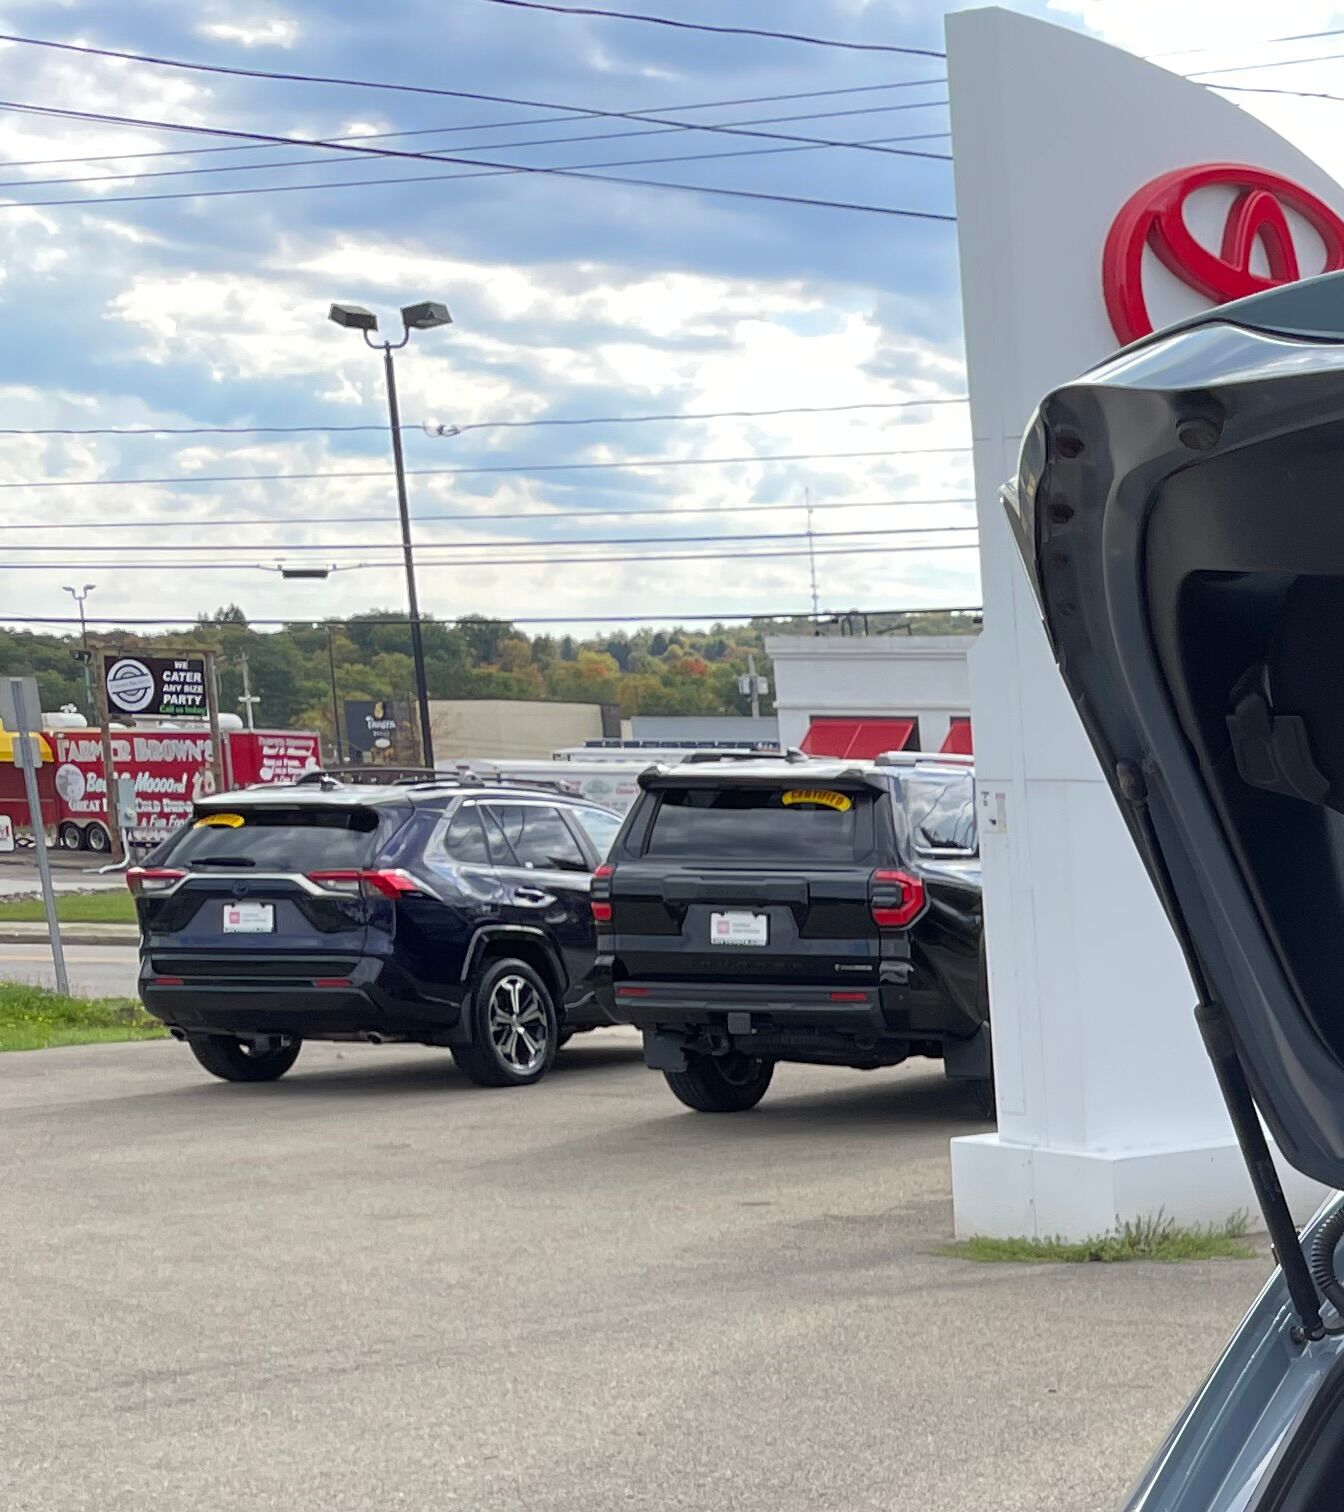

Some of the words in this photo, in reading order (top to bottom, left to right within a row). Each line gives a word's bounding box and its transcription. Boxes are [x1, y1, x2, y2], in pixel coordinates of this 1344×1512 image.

[174, 660, 189, 670] WE
[162, 670, 202, 683] CATER
[162, 683, 182, 693] ANY
[183, 684, 204, 694] SIZE
[163, 694, 202, 706] PARTY
